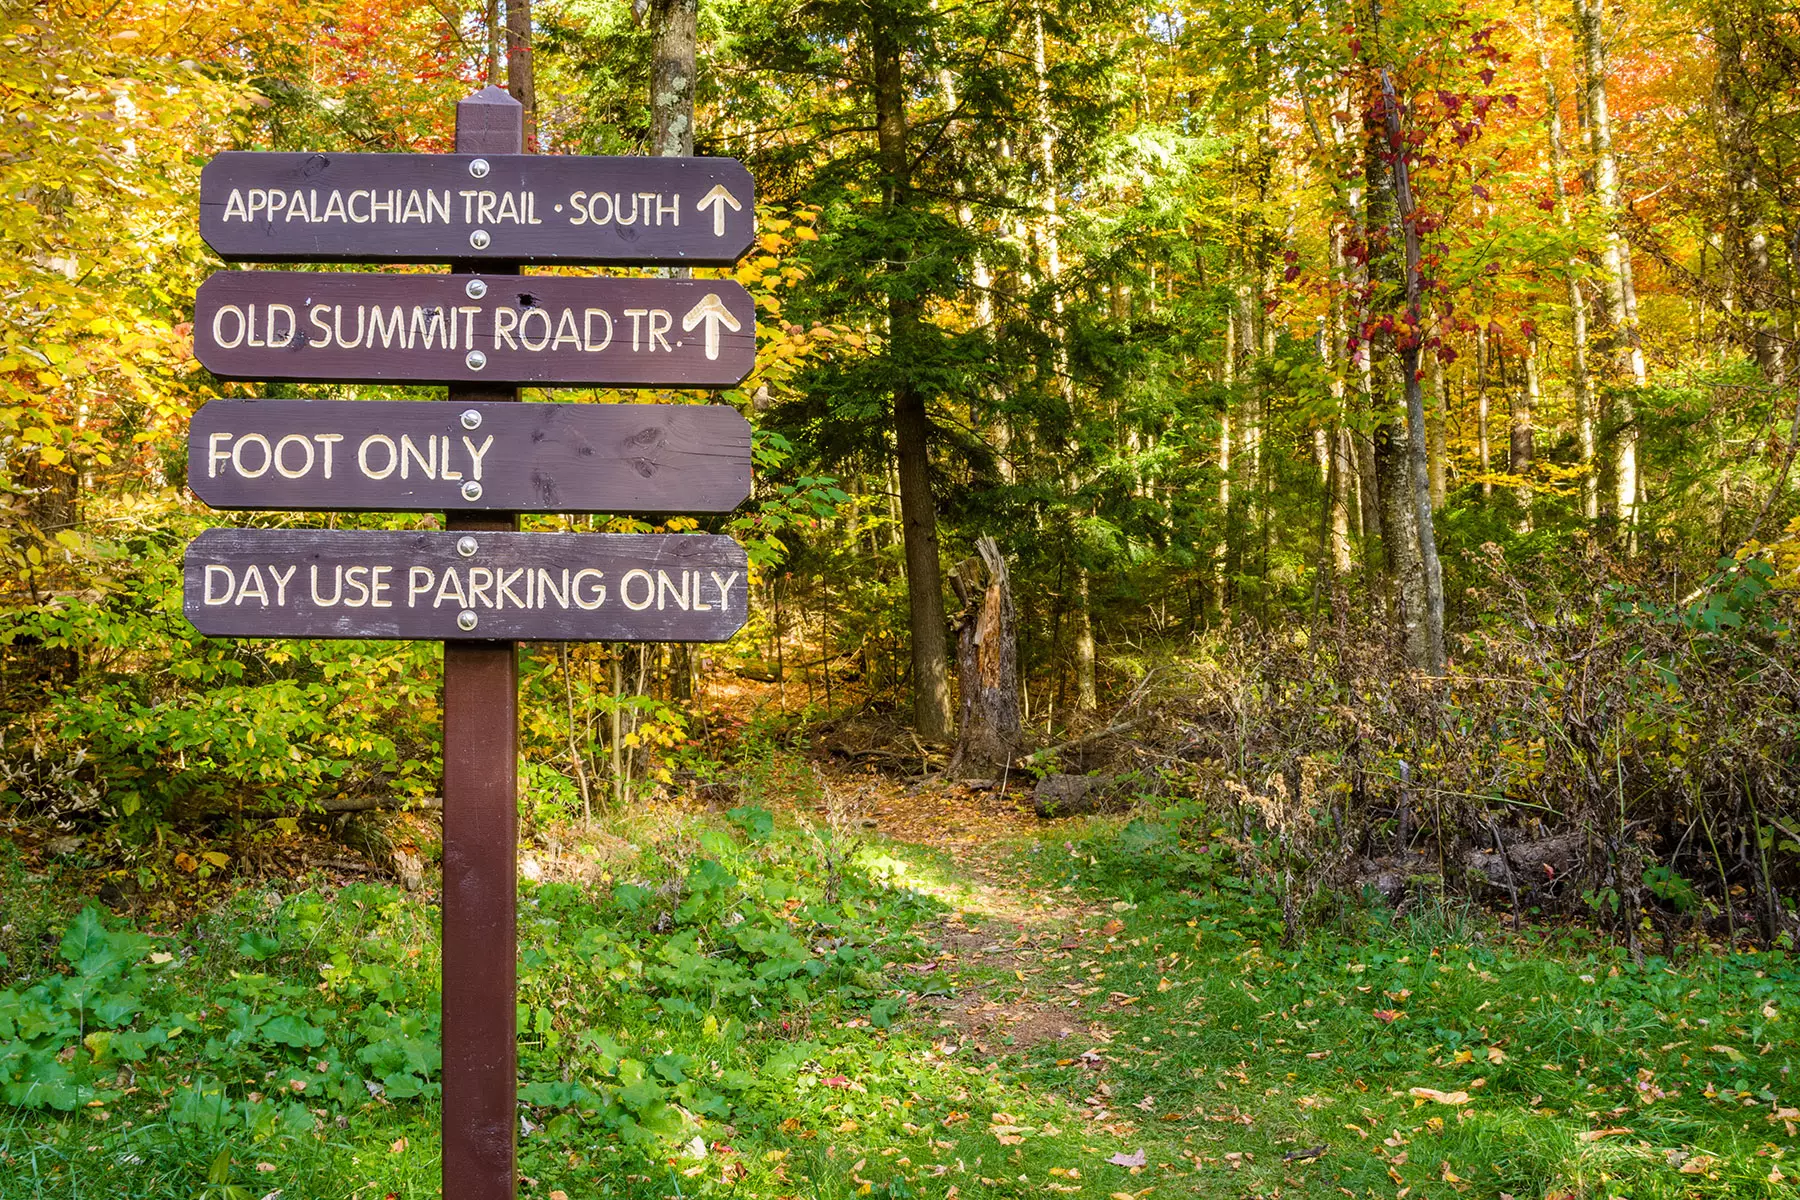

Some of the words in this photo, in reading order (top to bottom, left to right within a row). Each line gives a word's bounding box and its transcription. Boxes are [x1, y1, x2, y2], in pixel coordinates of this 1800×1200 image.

[222, 189, 451, 224] APPALACHIAN
[459, 190, 542, 225] TRAIL
[569, 191, 680, 227] SOUTH
[212, 303, 297, 349] OLD
[308, 304, 483, 351] SUMMIT
[494, 307, 611, 353] ROAD
[624, 308, 683, 353] TR.
[207, 432, 344, 480] FOOT
[357, 434, 495, 481] ONLY
[203, 564, 297, 607] DAY
[310, 565, 393, 608] USE
[407, 566, 607, 610] PARKING
[619, 569, 740, 612] ONLY
